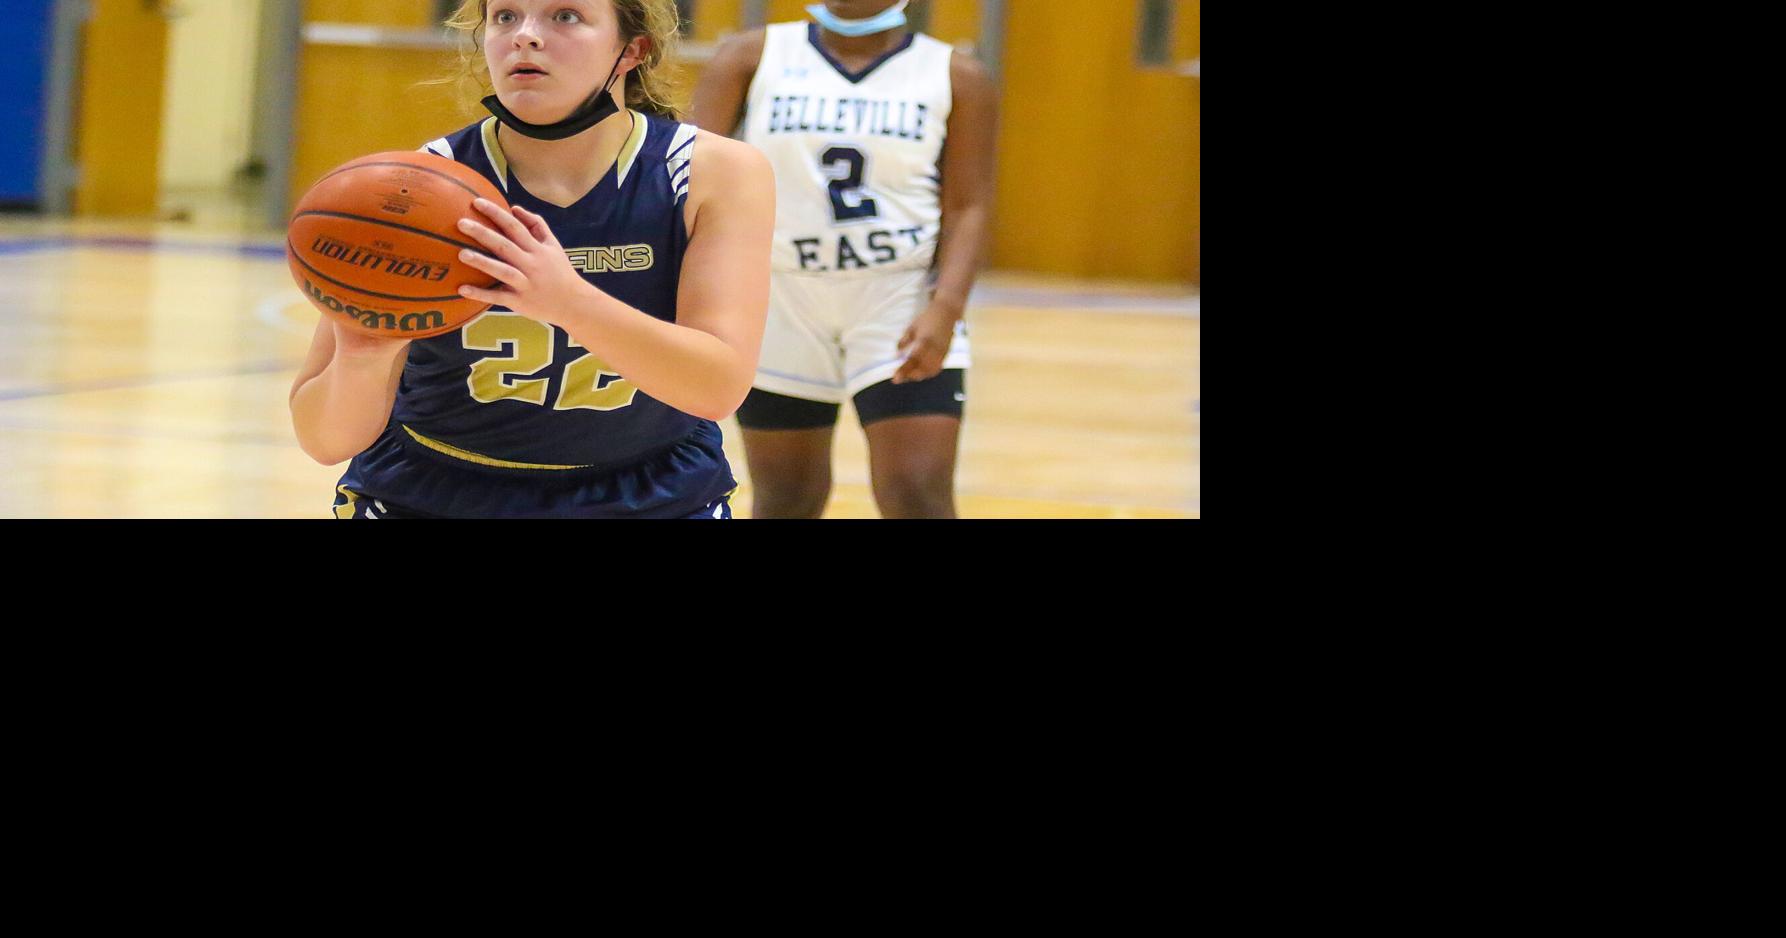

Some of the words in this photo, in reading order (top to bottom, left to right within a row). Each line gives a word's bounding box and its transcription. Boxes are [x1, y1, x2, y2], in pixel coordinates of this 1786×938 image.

[768, 95, 928, 140] BELLEVILLE
[820, 146, 878, 222] 2
[311, 237, 450, 282] EVOLUTION
[792, 229, 924, 271] EAST
[304, 277, 447, 332] Wilson
